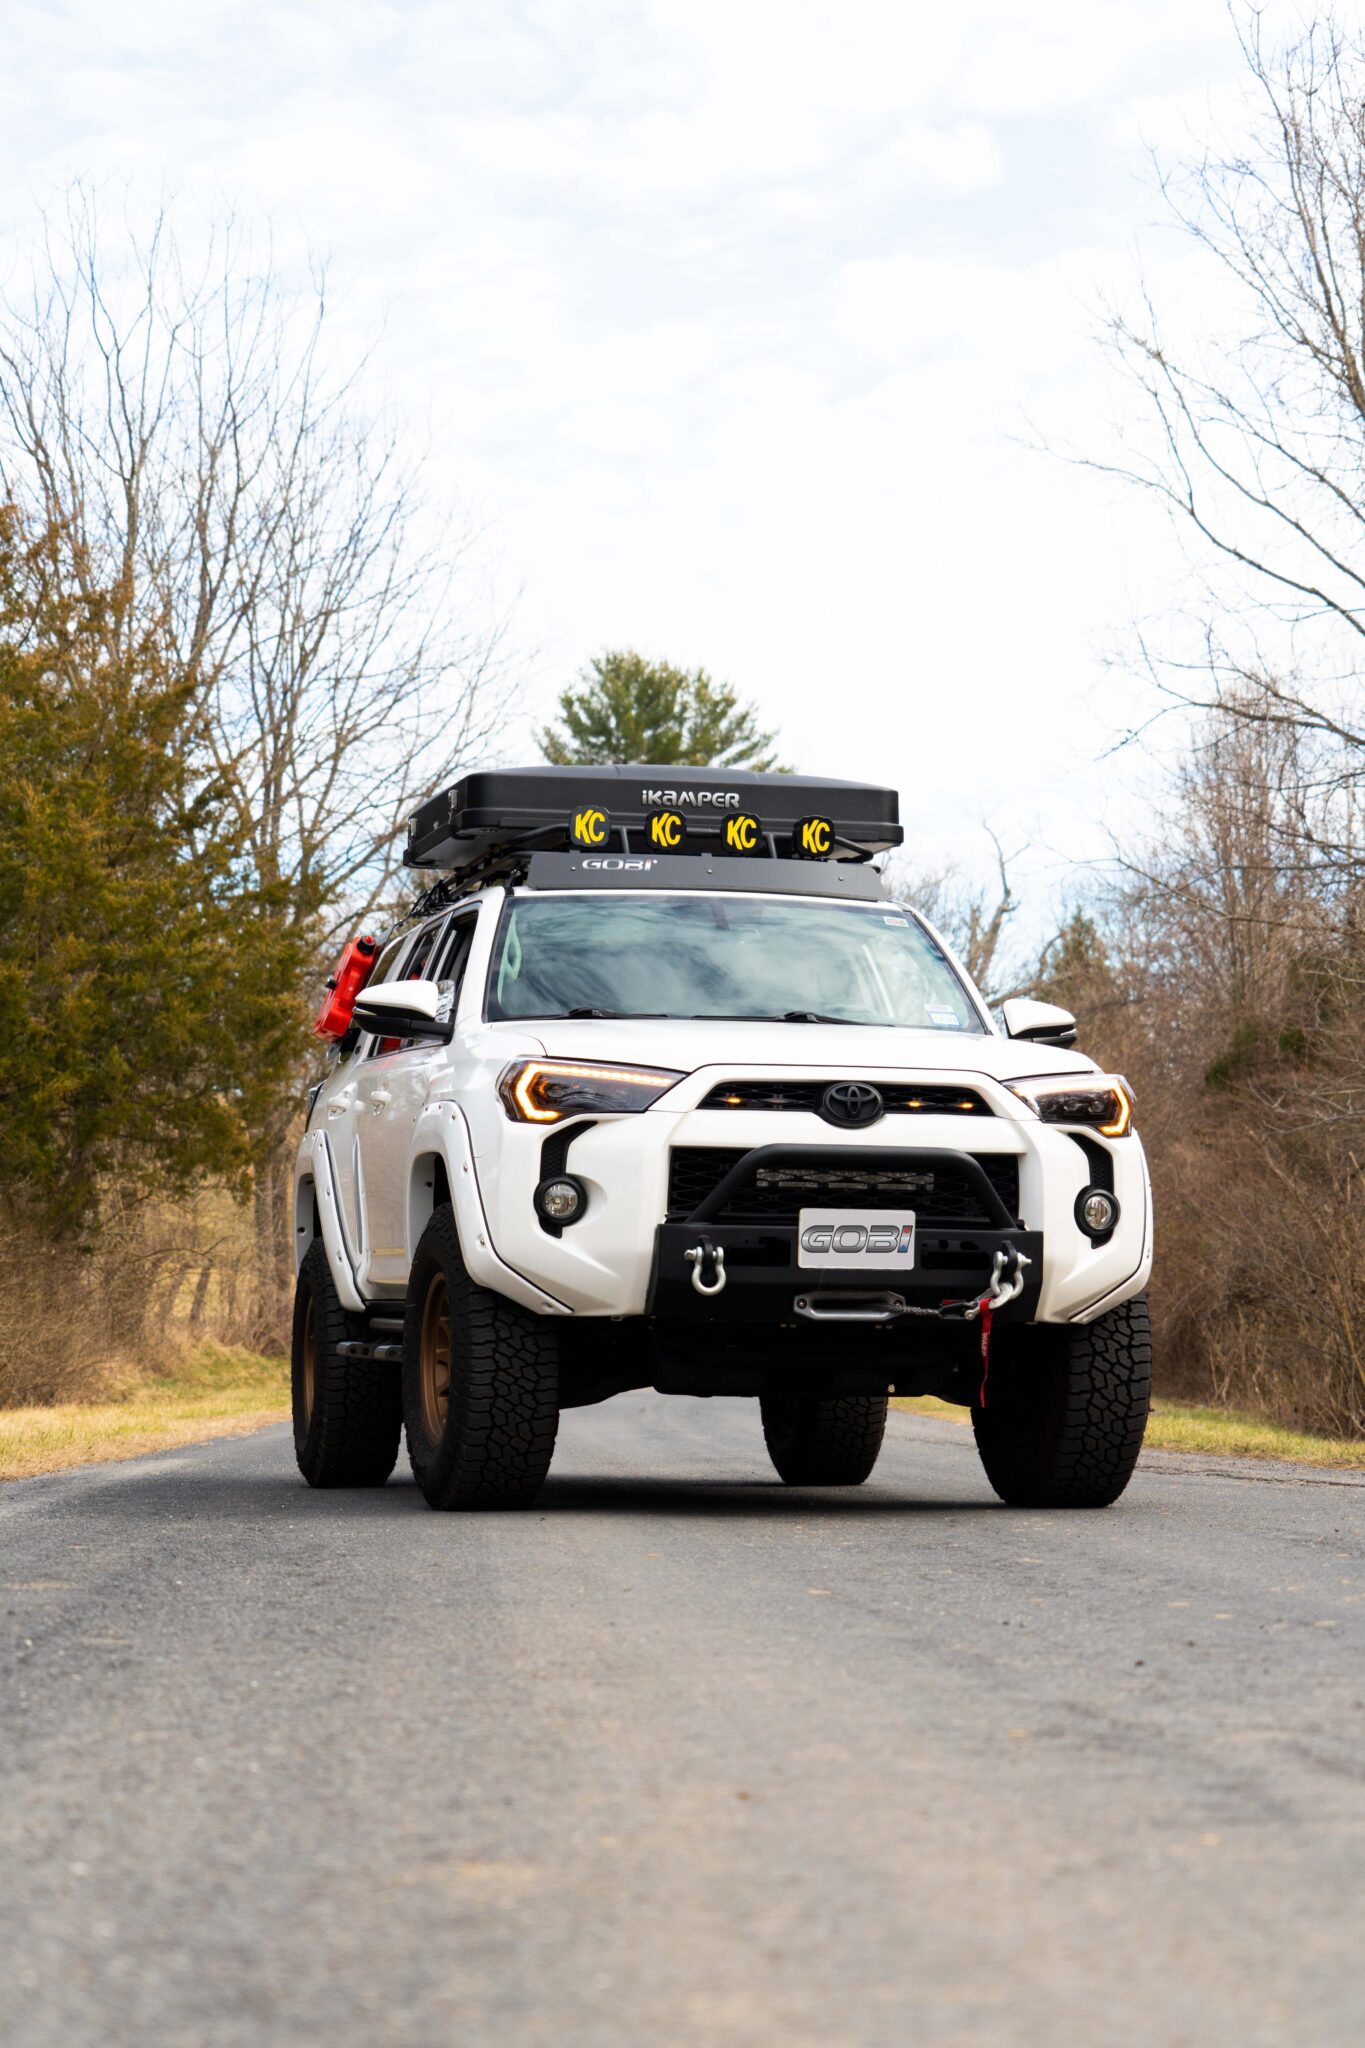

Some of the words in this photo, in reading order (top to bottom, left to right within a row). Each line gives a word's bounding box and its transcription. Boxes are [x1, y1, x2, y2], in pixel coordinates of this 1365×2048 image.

[575, 809, 606, 844] KC
[651, 812, 682, 847] KC
[726, 816, 757, 850] KC
[802, 819, 831, 853] KC
[582, 858, 652, 872] GOBI
[801, 1225, 913, 1253] GOBI
